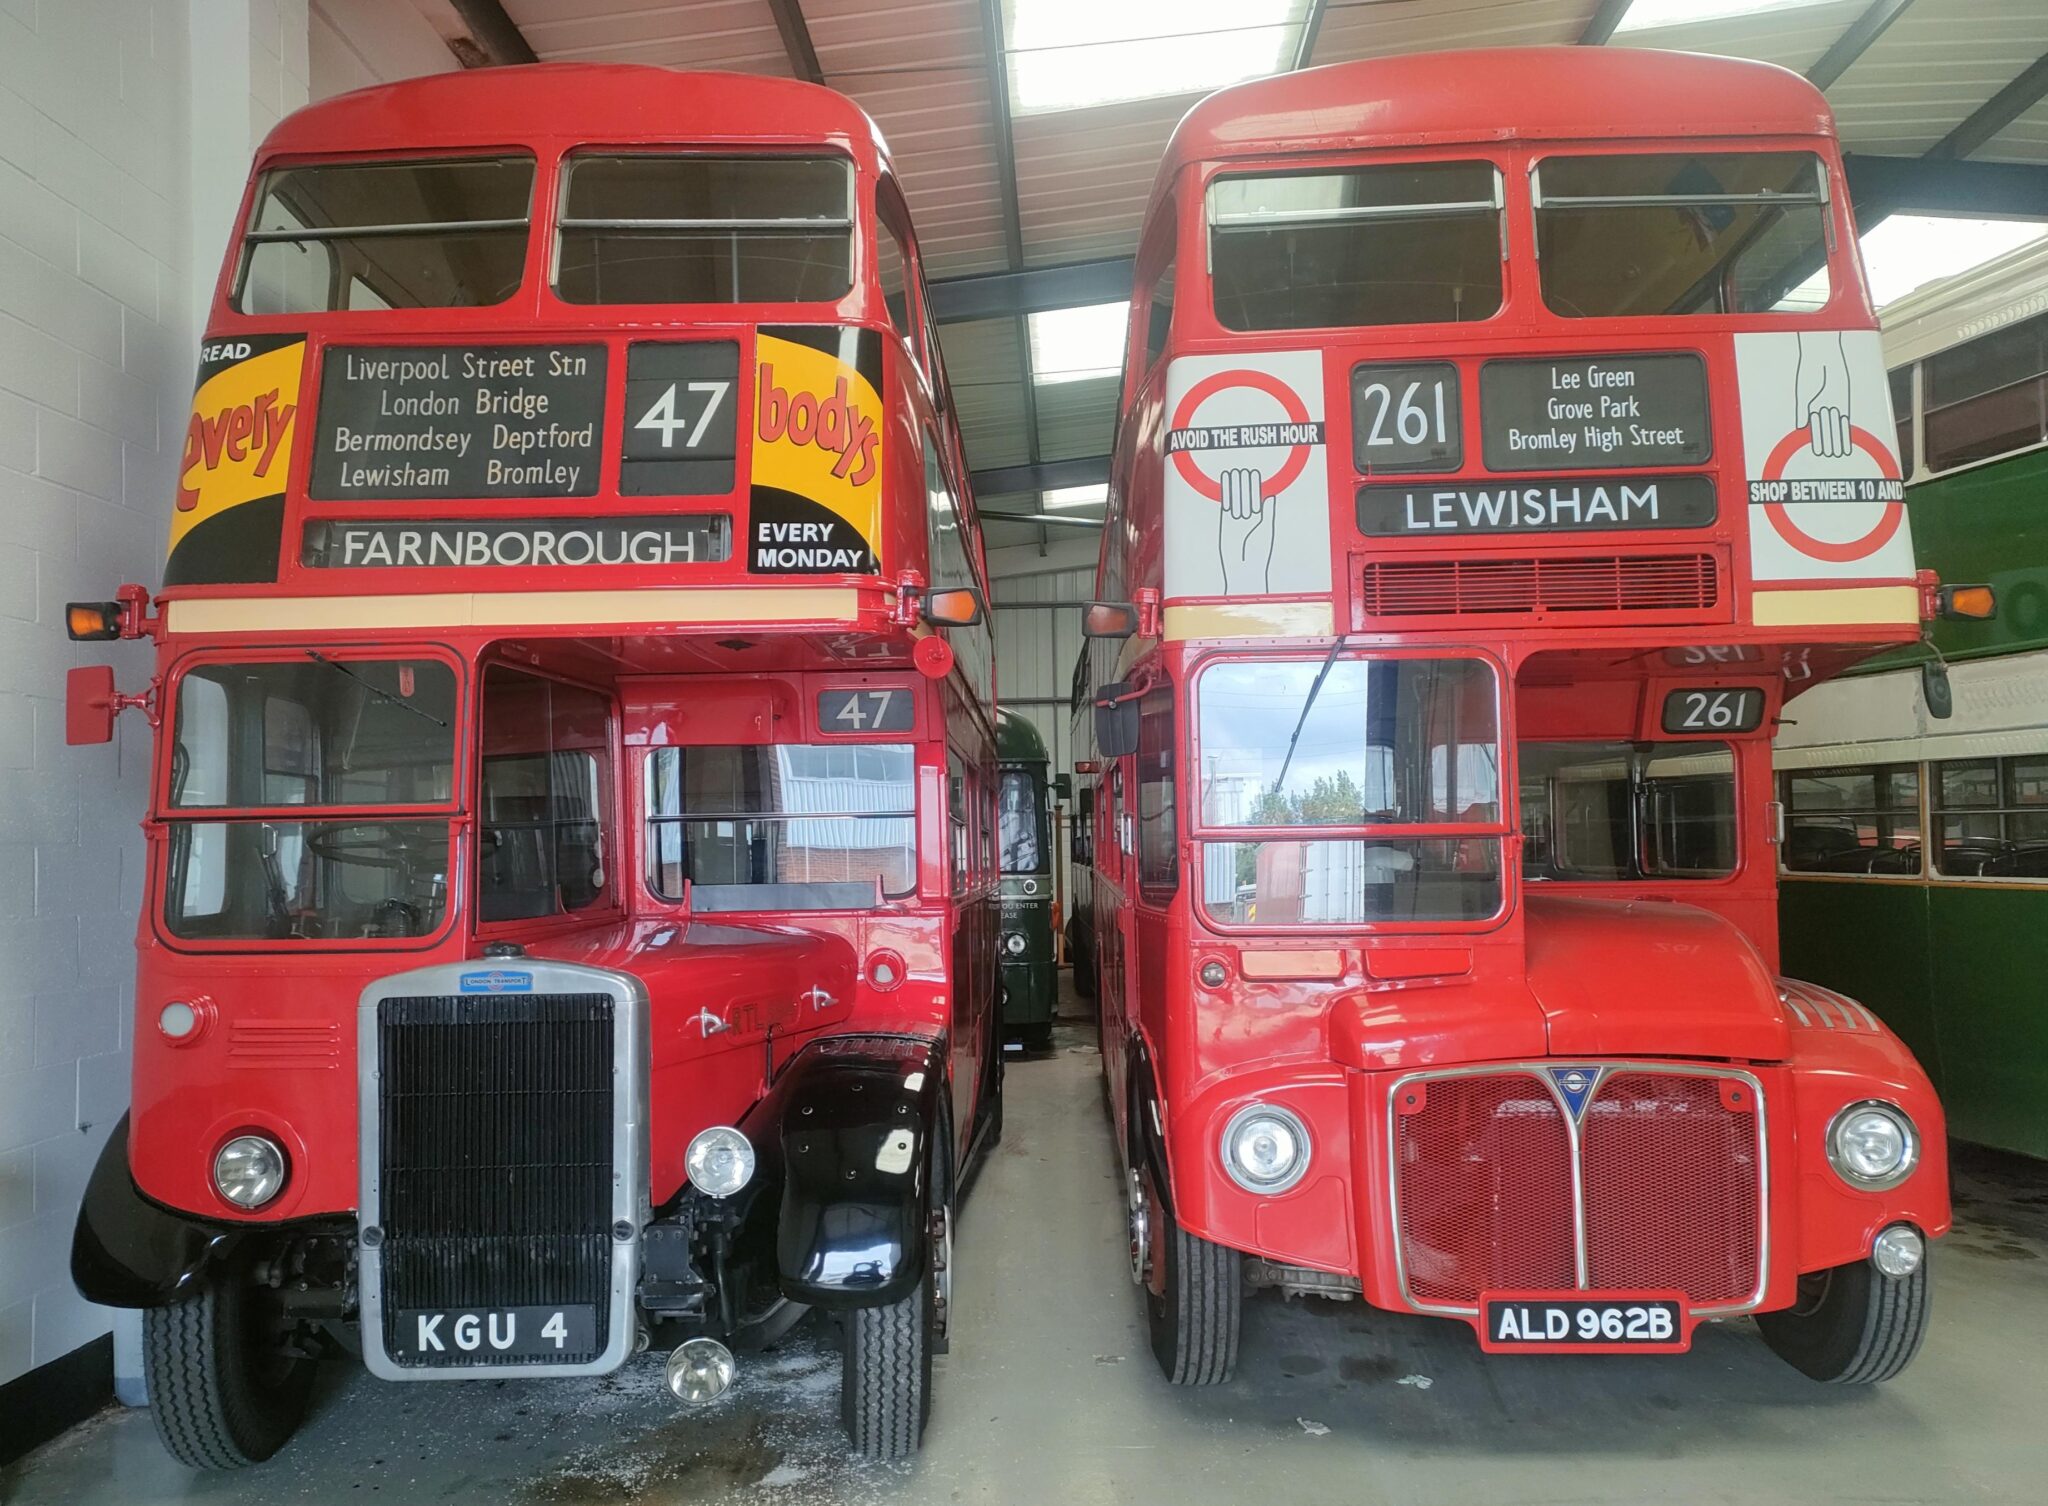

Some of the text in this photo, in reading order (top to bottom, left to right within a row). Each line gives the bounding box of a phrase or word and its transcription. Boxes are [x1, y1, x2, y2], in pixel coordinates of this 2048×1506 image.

[200, 342, 251, 365] READ
[346, 350, 587, 386] Liverpool Street Stn
[1551, 365, 1635, 390] Lee Green
[381, 387, 549, 420] London Bridge
[634, 382, 731, 448] 47
[1364, 380, 1447, 447] 261
[1547, 395, 1641, 420] Grove Park
[335, 422, 593, 458] Bermondsey Deptford
[758, 362, 880, 487] bodys
[1170, 424, 1319, 450] AVOID THE RUSH HOUR
[1508, 423, 1685, 454] Bromley High Street
[176, 387, 297, 513] every
[340, 459, 580, 493] Lewisham Bromley
[1750, 480, 1904, 502] SHOP BETWEEN 10 AND
[1406, 484, 1660, 530] LEWISHAM
[343, 530, 695, 566] FARNBOROUGH
[758, 522, 835, 542] EVERY
[757, 548, 863, 568] MONDAY
[835, 690, 893, 729] 47
[1682, 692, 1746, 727] 261
[1016, 902, 1040, 910] ENTER
[465, 977, 527, 986] LONDON TRANSPORT
[417, 1312, 568, 1352] KGU 4
[1498, 1307, 1674, 1340] ALD 962B
